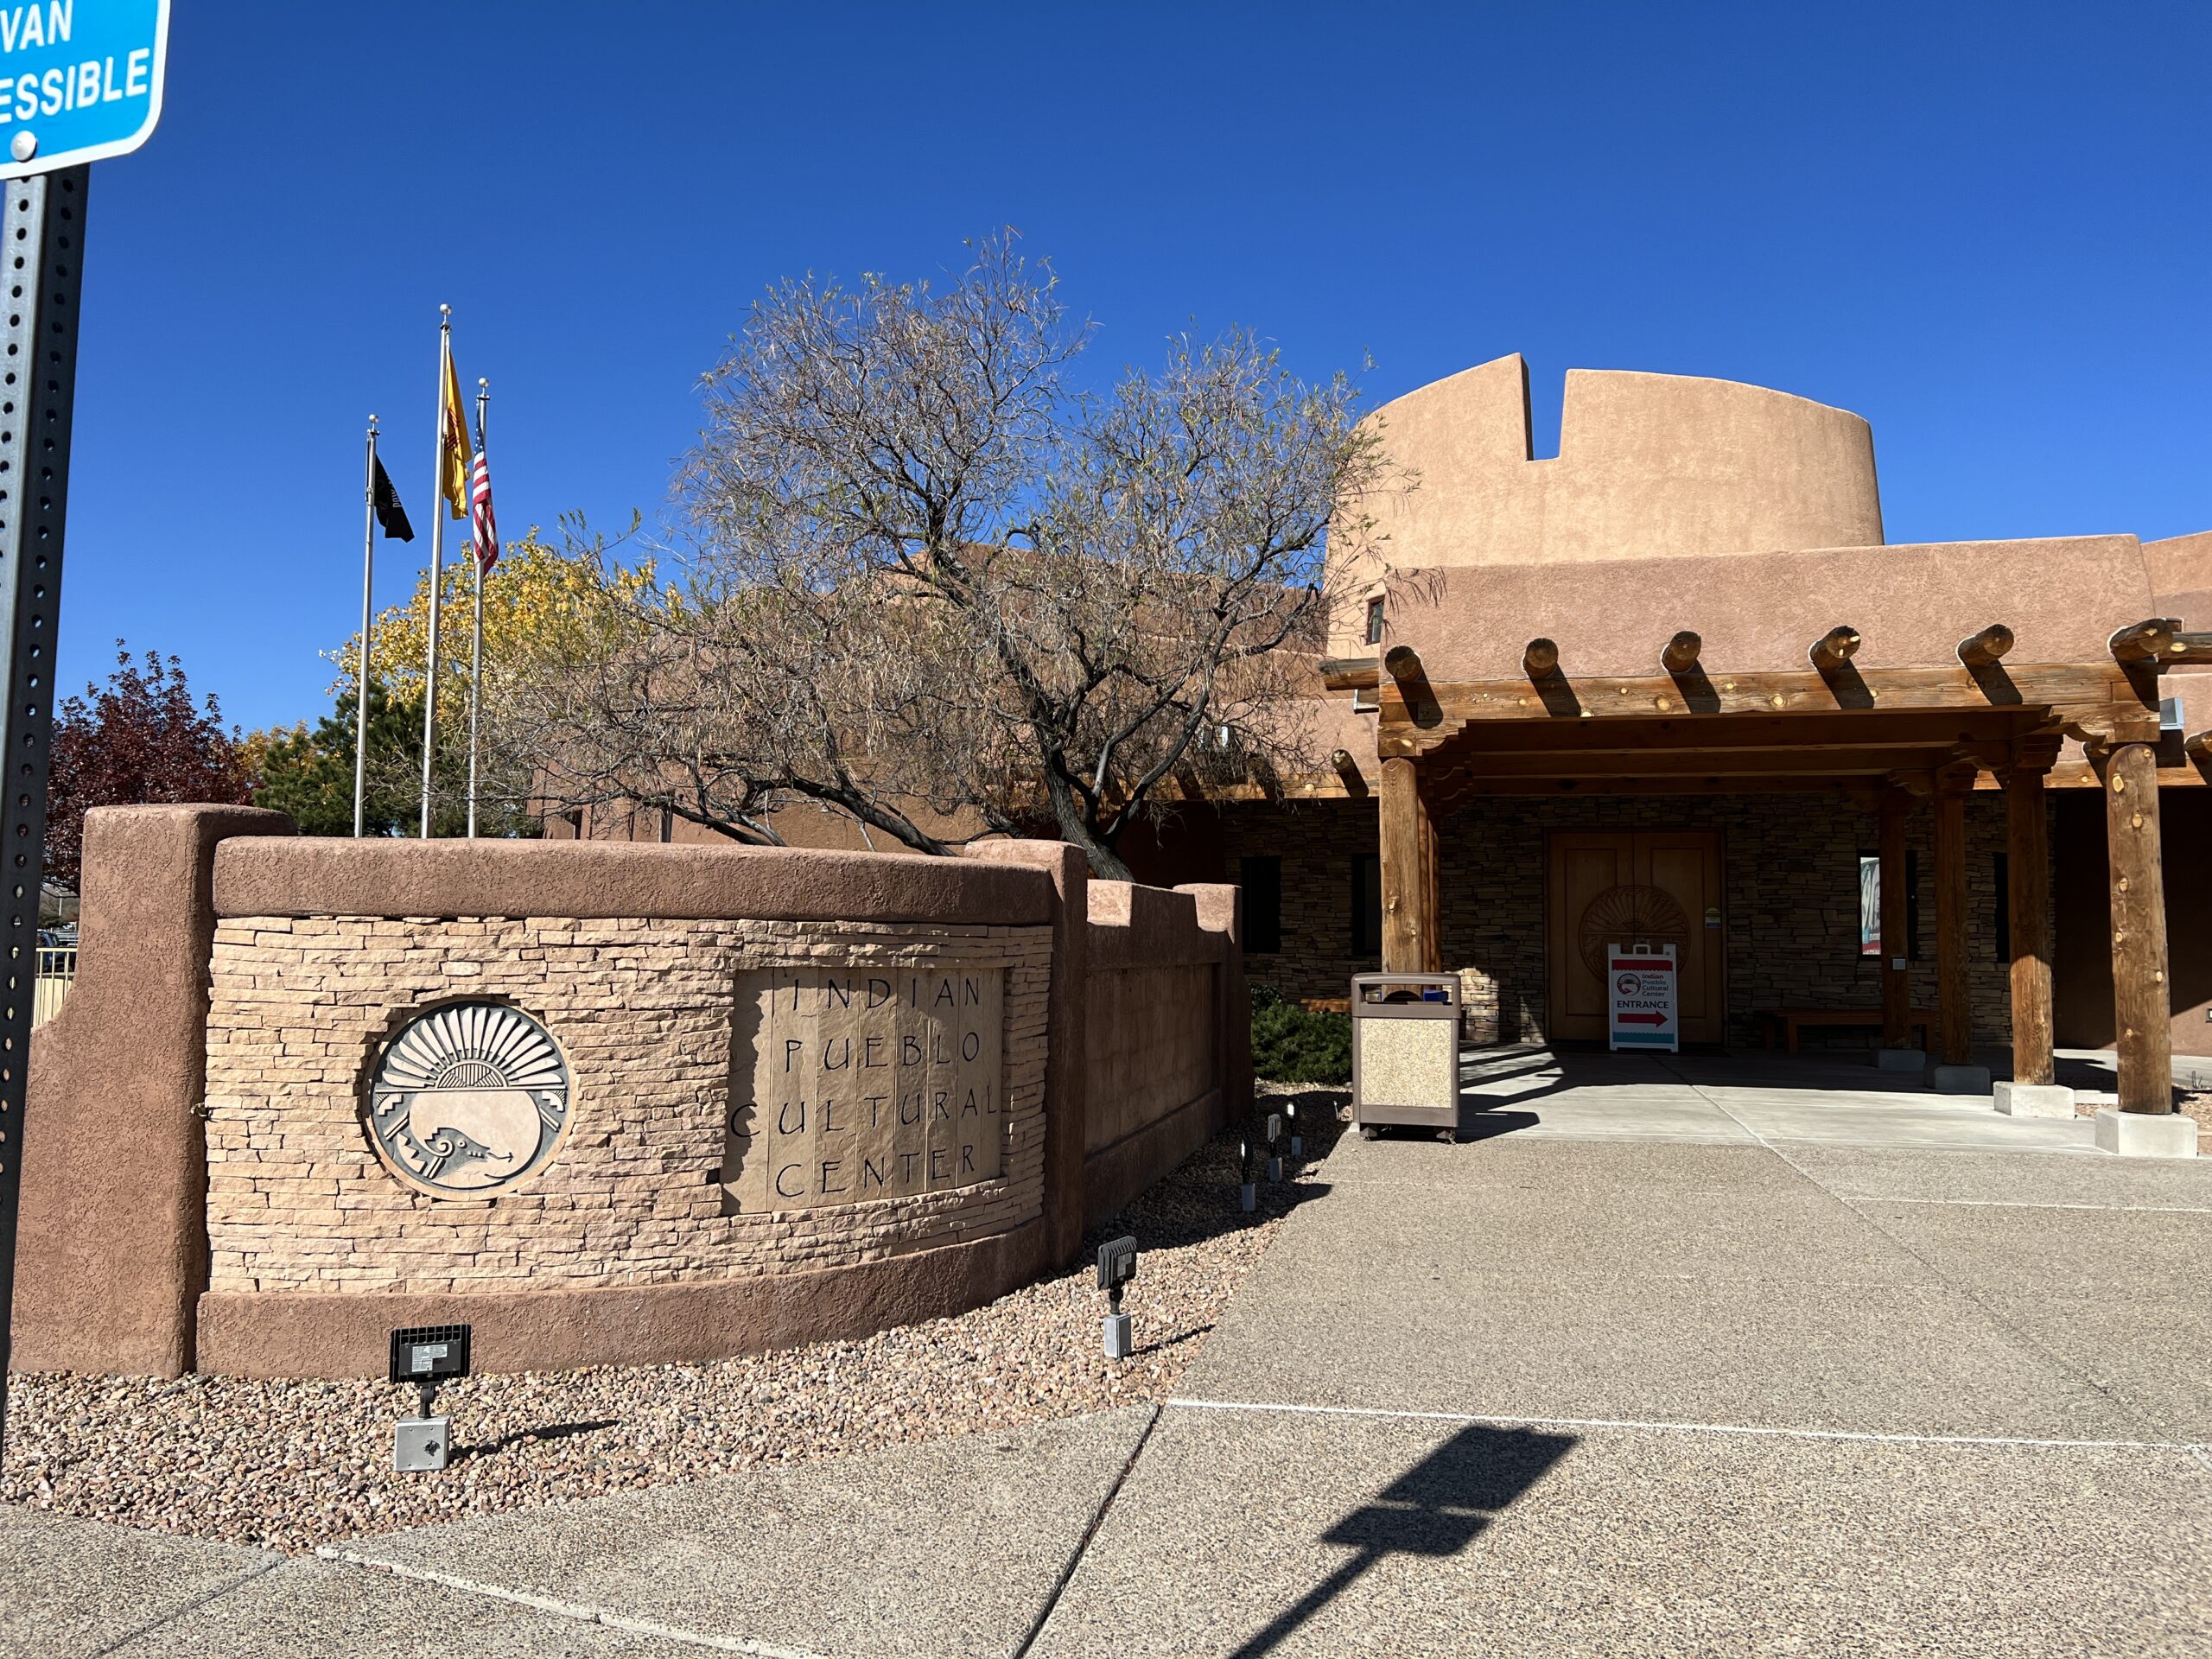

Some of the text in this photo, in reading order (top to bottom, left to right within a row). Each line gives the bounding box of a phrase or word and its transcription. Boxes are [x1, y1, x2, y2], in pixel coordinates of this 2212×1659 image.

[0, 0, 73, 54] VAN
[793, 977, 979, 1010] INDIAN
[1617, 1000, 1669, 1009] ENTRANCE
[785, 1032, 980, 1073] PUEBLO
[730, 1084, 997, 1138] CULTURAL
[775, 1145, 976, 1198] CENTER
